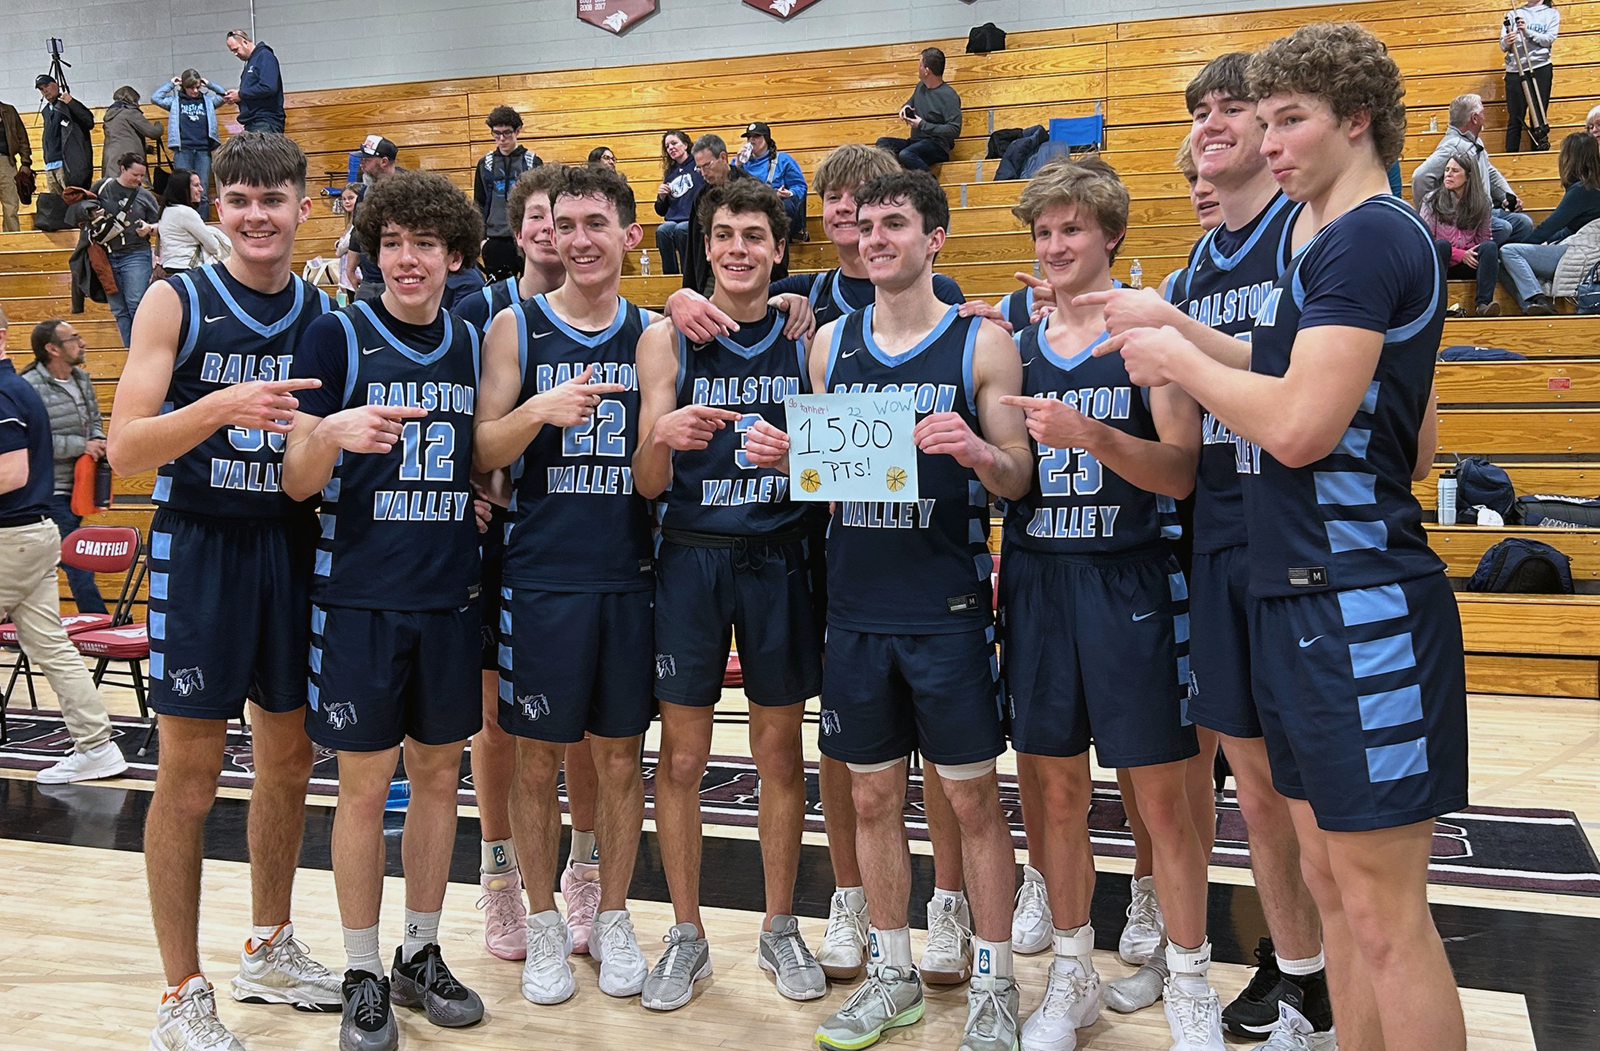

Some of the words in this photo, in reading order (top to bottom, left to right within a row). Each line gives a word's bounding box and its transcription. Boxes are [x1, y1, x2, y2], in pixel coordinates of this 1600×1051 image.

[200, 352, 294, 384] RALST
[367, 382, 474, 416] RALSTON
[692, 376, 800, 406] RALSTON
[847, 406, 863, 418] 22
[873, 398, 913, 415] WOW
[399, 421, 456, 481] 12
[210, 457, 283, 492] VALL
[547, 465, 633, 495] VALLEY
[822, 457, 871, 482] PTS!
[1037, 442, 1103, 497] 23
[373, 490, 469, 521] VALLEY
[701, 475, 789, 506] VALLEY
[842, 498, 936, 529] VALLEY
[75, 539, 129, 556] CHATFIELD
